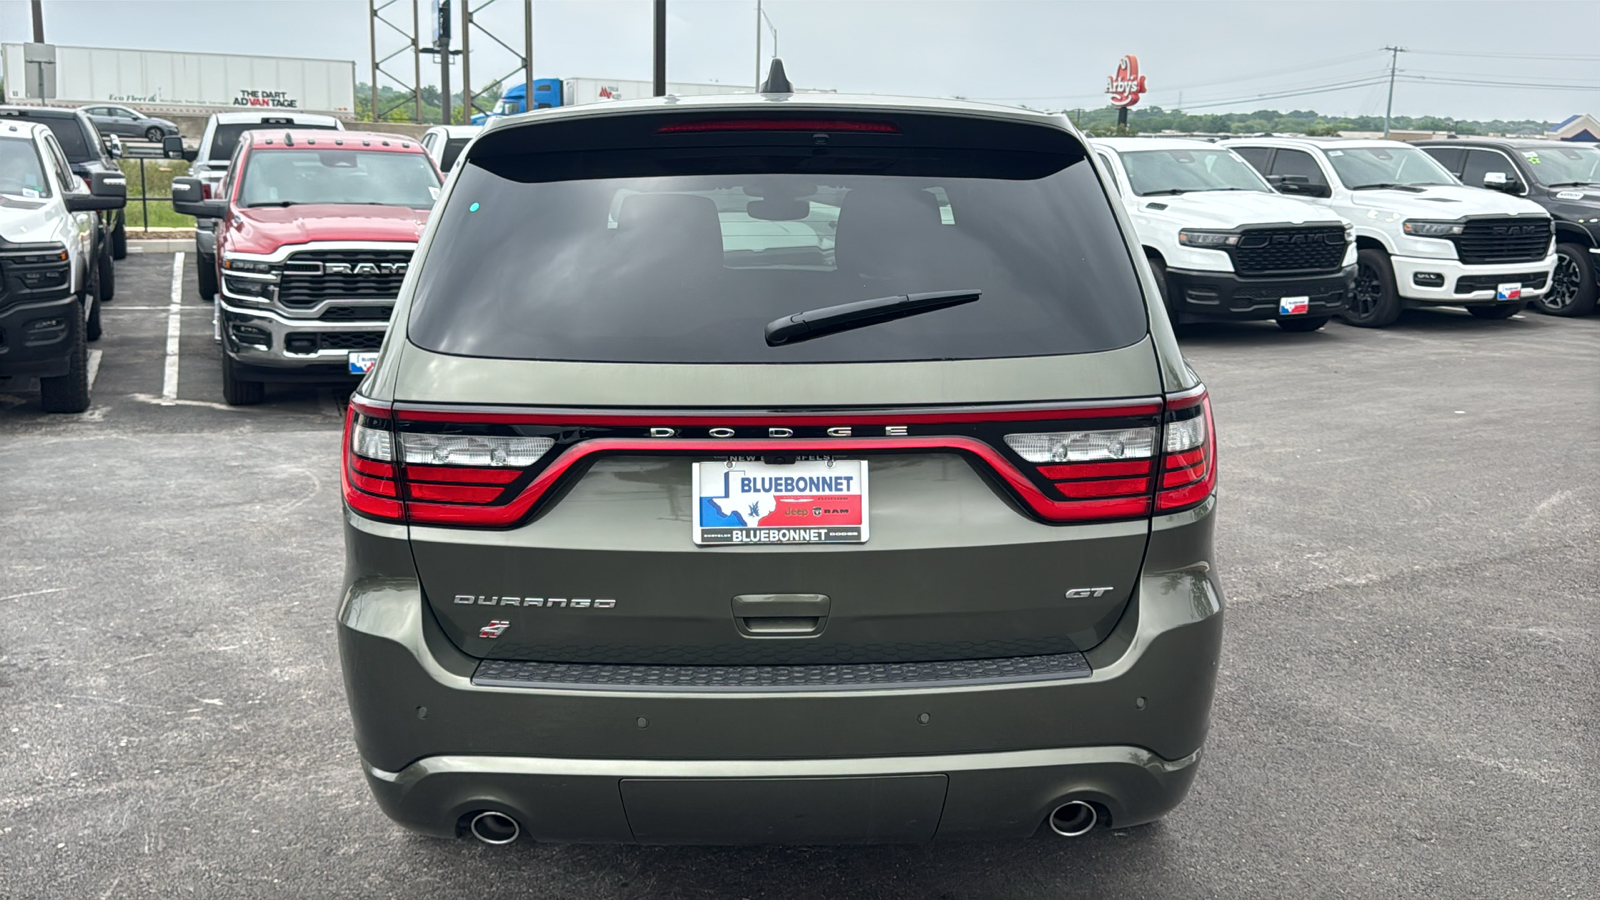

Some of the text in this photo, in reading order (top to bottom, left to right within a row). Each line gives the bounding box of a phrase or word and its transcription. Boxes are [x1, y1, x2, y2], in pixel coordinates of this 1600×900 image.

[1105, 76, 1139, 97] Arby's
[240, 90, 287, 99] THE DART
[1491, 226, 1535, 236] RAM
[1271, 233, 1325, 243] RAM
[325, 262, 407, 274] RAM
[650, 425, 909, 438] DODGE
[740, 476, 854, 494] BLUEBONNET
[784, 507, 809, 517] Jeep
[732, 529, 828, 542] BLUEBONNET
[1065, 586, 1114, 599] GT
[453, 594, 617, 609] DURANGO
